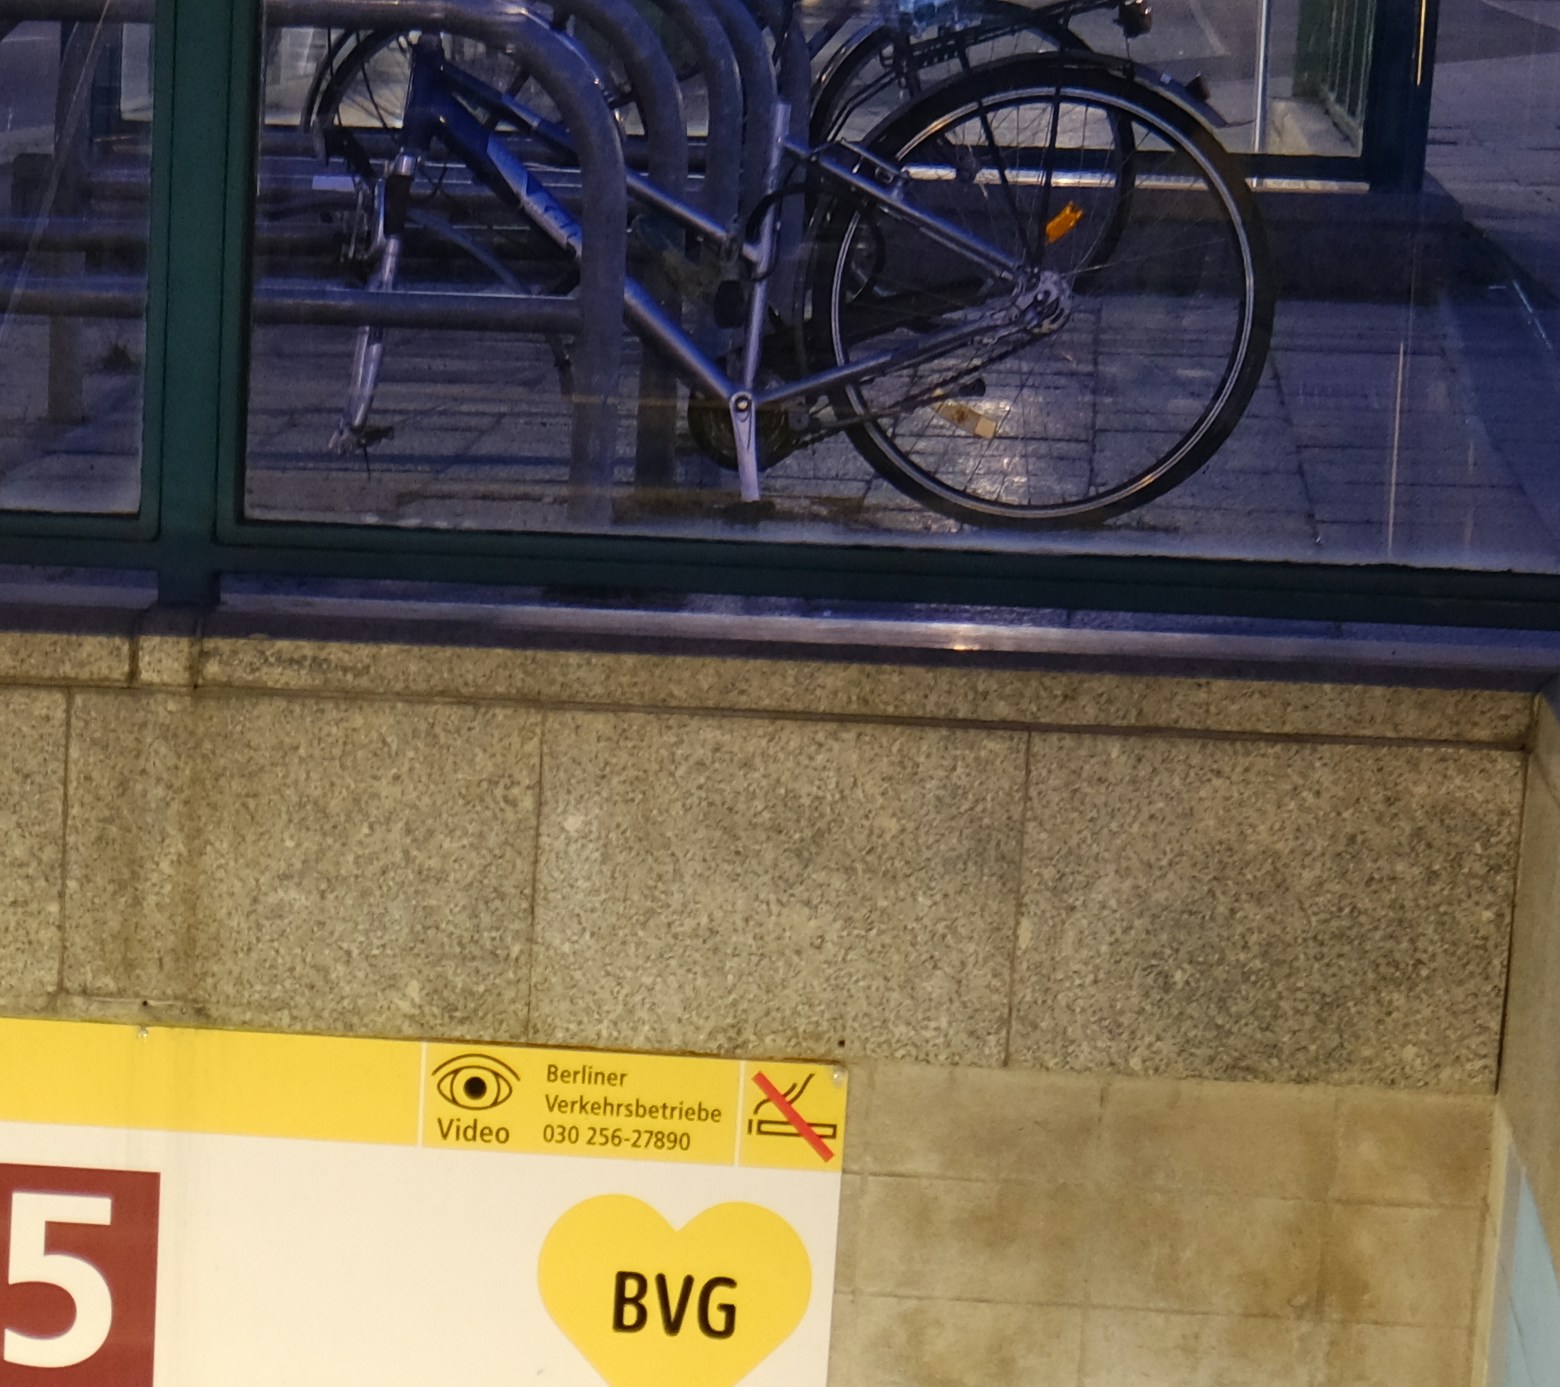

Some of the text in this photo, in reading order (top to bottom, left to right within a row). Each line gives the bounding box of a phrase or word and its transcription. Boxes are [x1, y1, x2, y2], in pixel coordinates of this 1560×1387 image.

[546, 1064, 628, 1087] Berliner
[545, 1094, 722, 1123] Verkehrsbetriebe
[437, 1117, 510, 1144] Video
[542, 1124, 691, 1151] 030 256-27890
[612, 1271, 738, 1340] BVG
